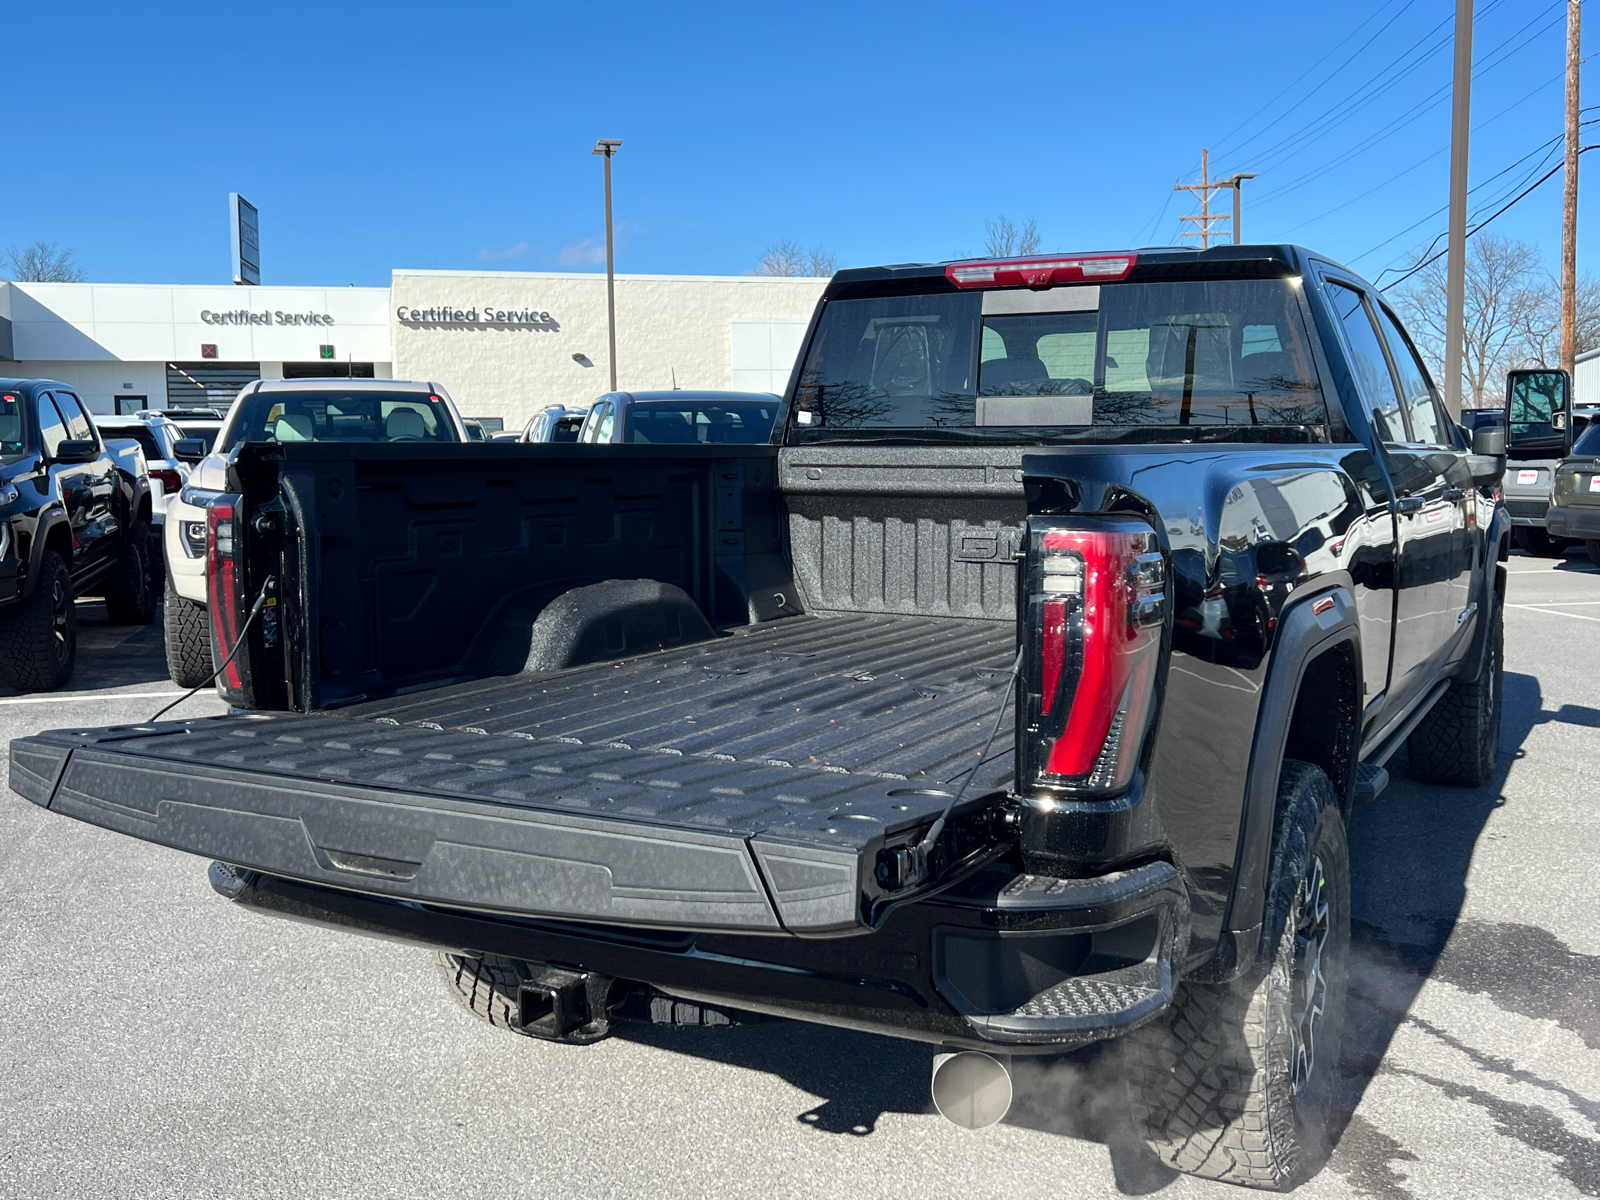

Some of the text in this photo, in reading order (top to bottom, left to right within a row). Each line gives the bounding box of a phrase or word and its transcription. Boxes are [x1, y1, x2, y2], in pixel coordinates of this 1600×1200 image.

[200, 309, 332, 325] Certified Service
[397, 306, 550, 323] Certified Service
